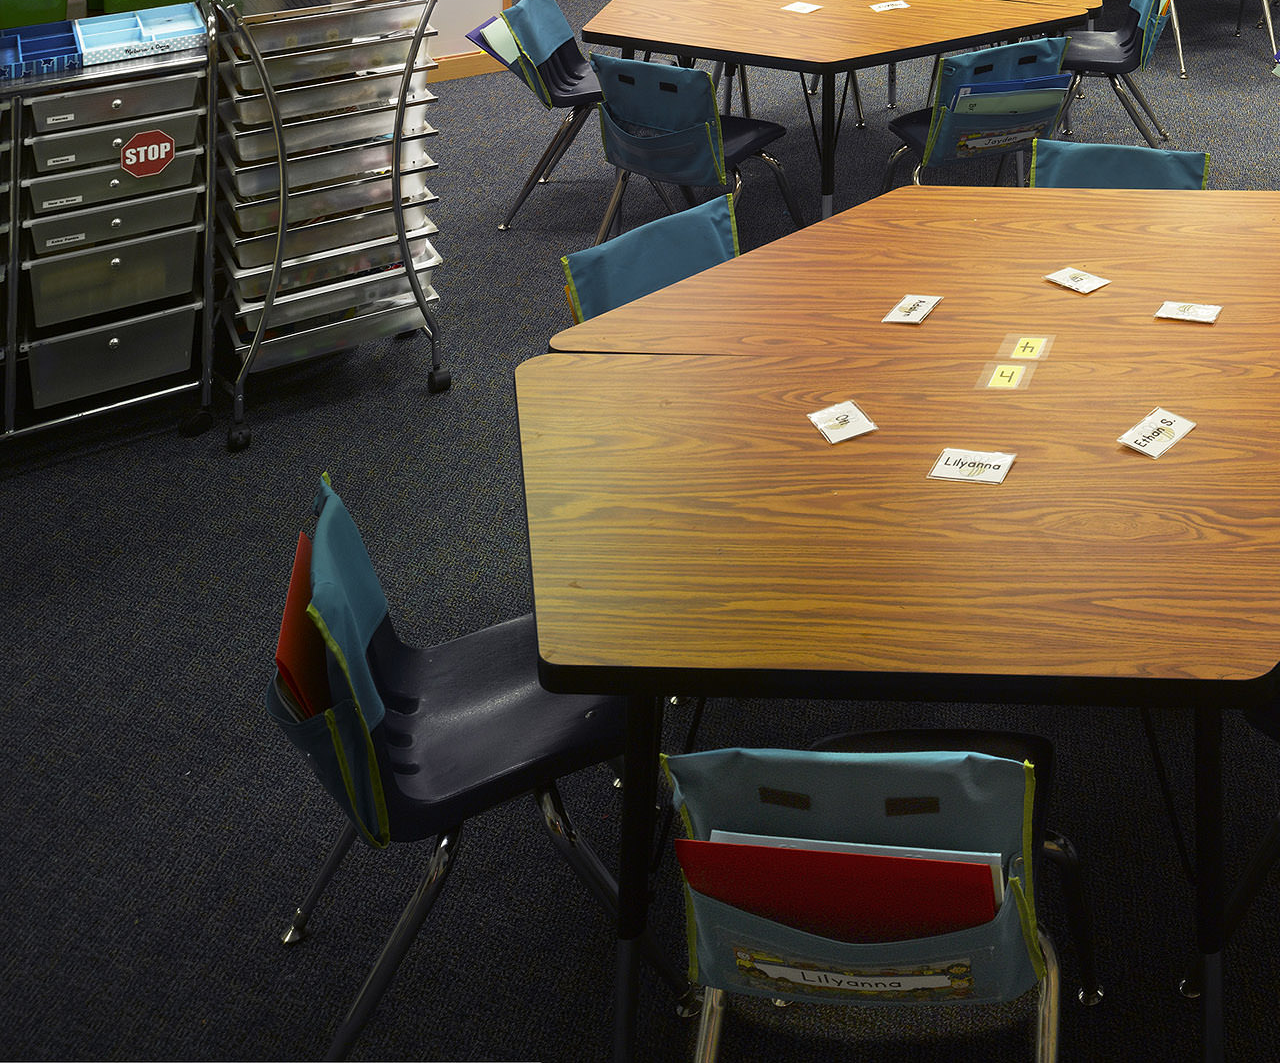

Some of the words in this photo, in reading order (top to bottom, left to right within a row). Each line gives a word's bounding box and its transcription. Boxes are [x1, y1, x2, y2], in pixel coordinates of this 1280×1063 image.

[984, 137, 1017, 145] Jayden
[125, 142, 171, 166] STOP
[1134, 426, 1166, 448] Ethan
[943, 456, 1001, 471] Lilyanna
[801, 971, 902, 989] Lilyanna
